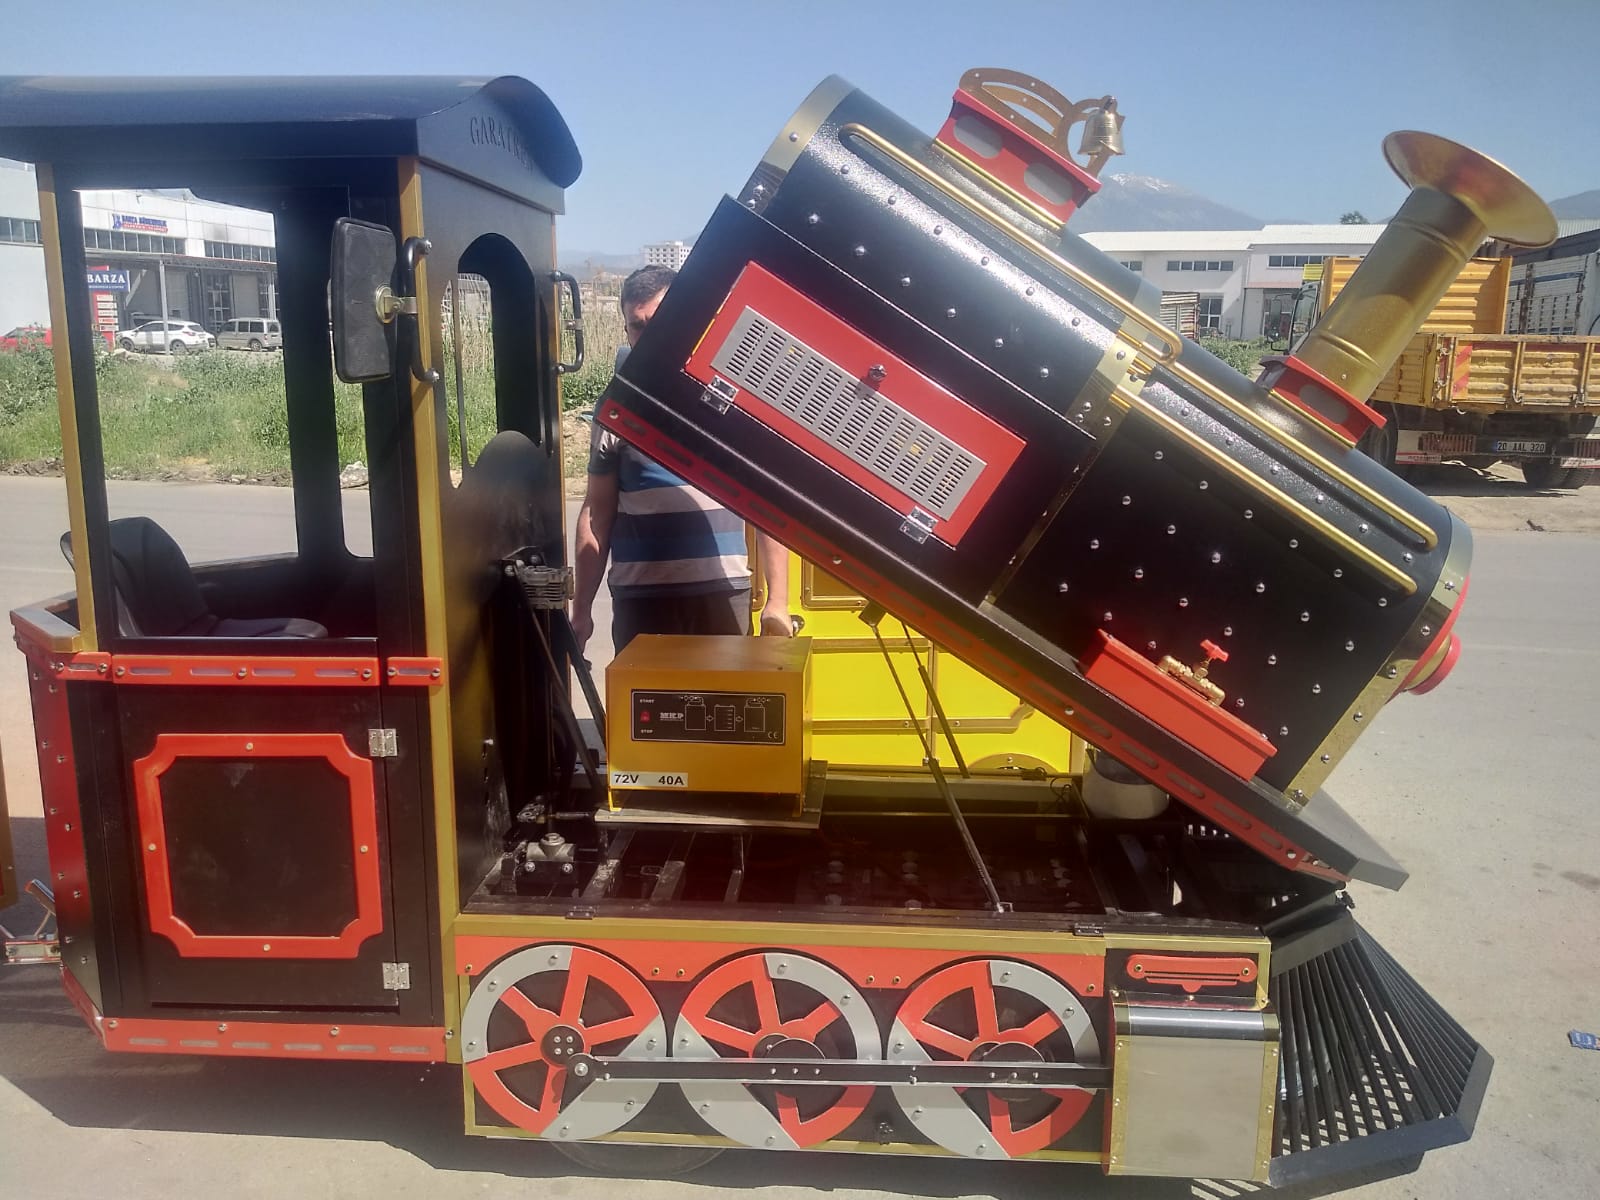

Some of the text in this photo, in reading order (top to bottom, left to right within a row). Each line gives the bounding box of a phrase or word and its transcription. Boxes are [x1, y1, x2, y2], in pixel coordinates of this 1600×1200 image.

[87, 273, 126, 284] BARZA
[614, 774, 685, 786] 72V 40A
